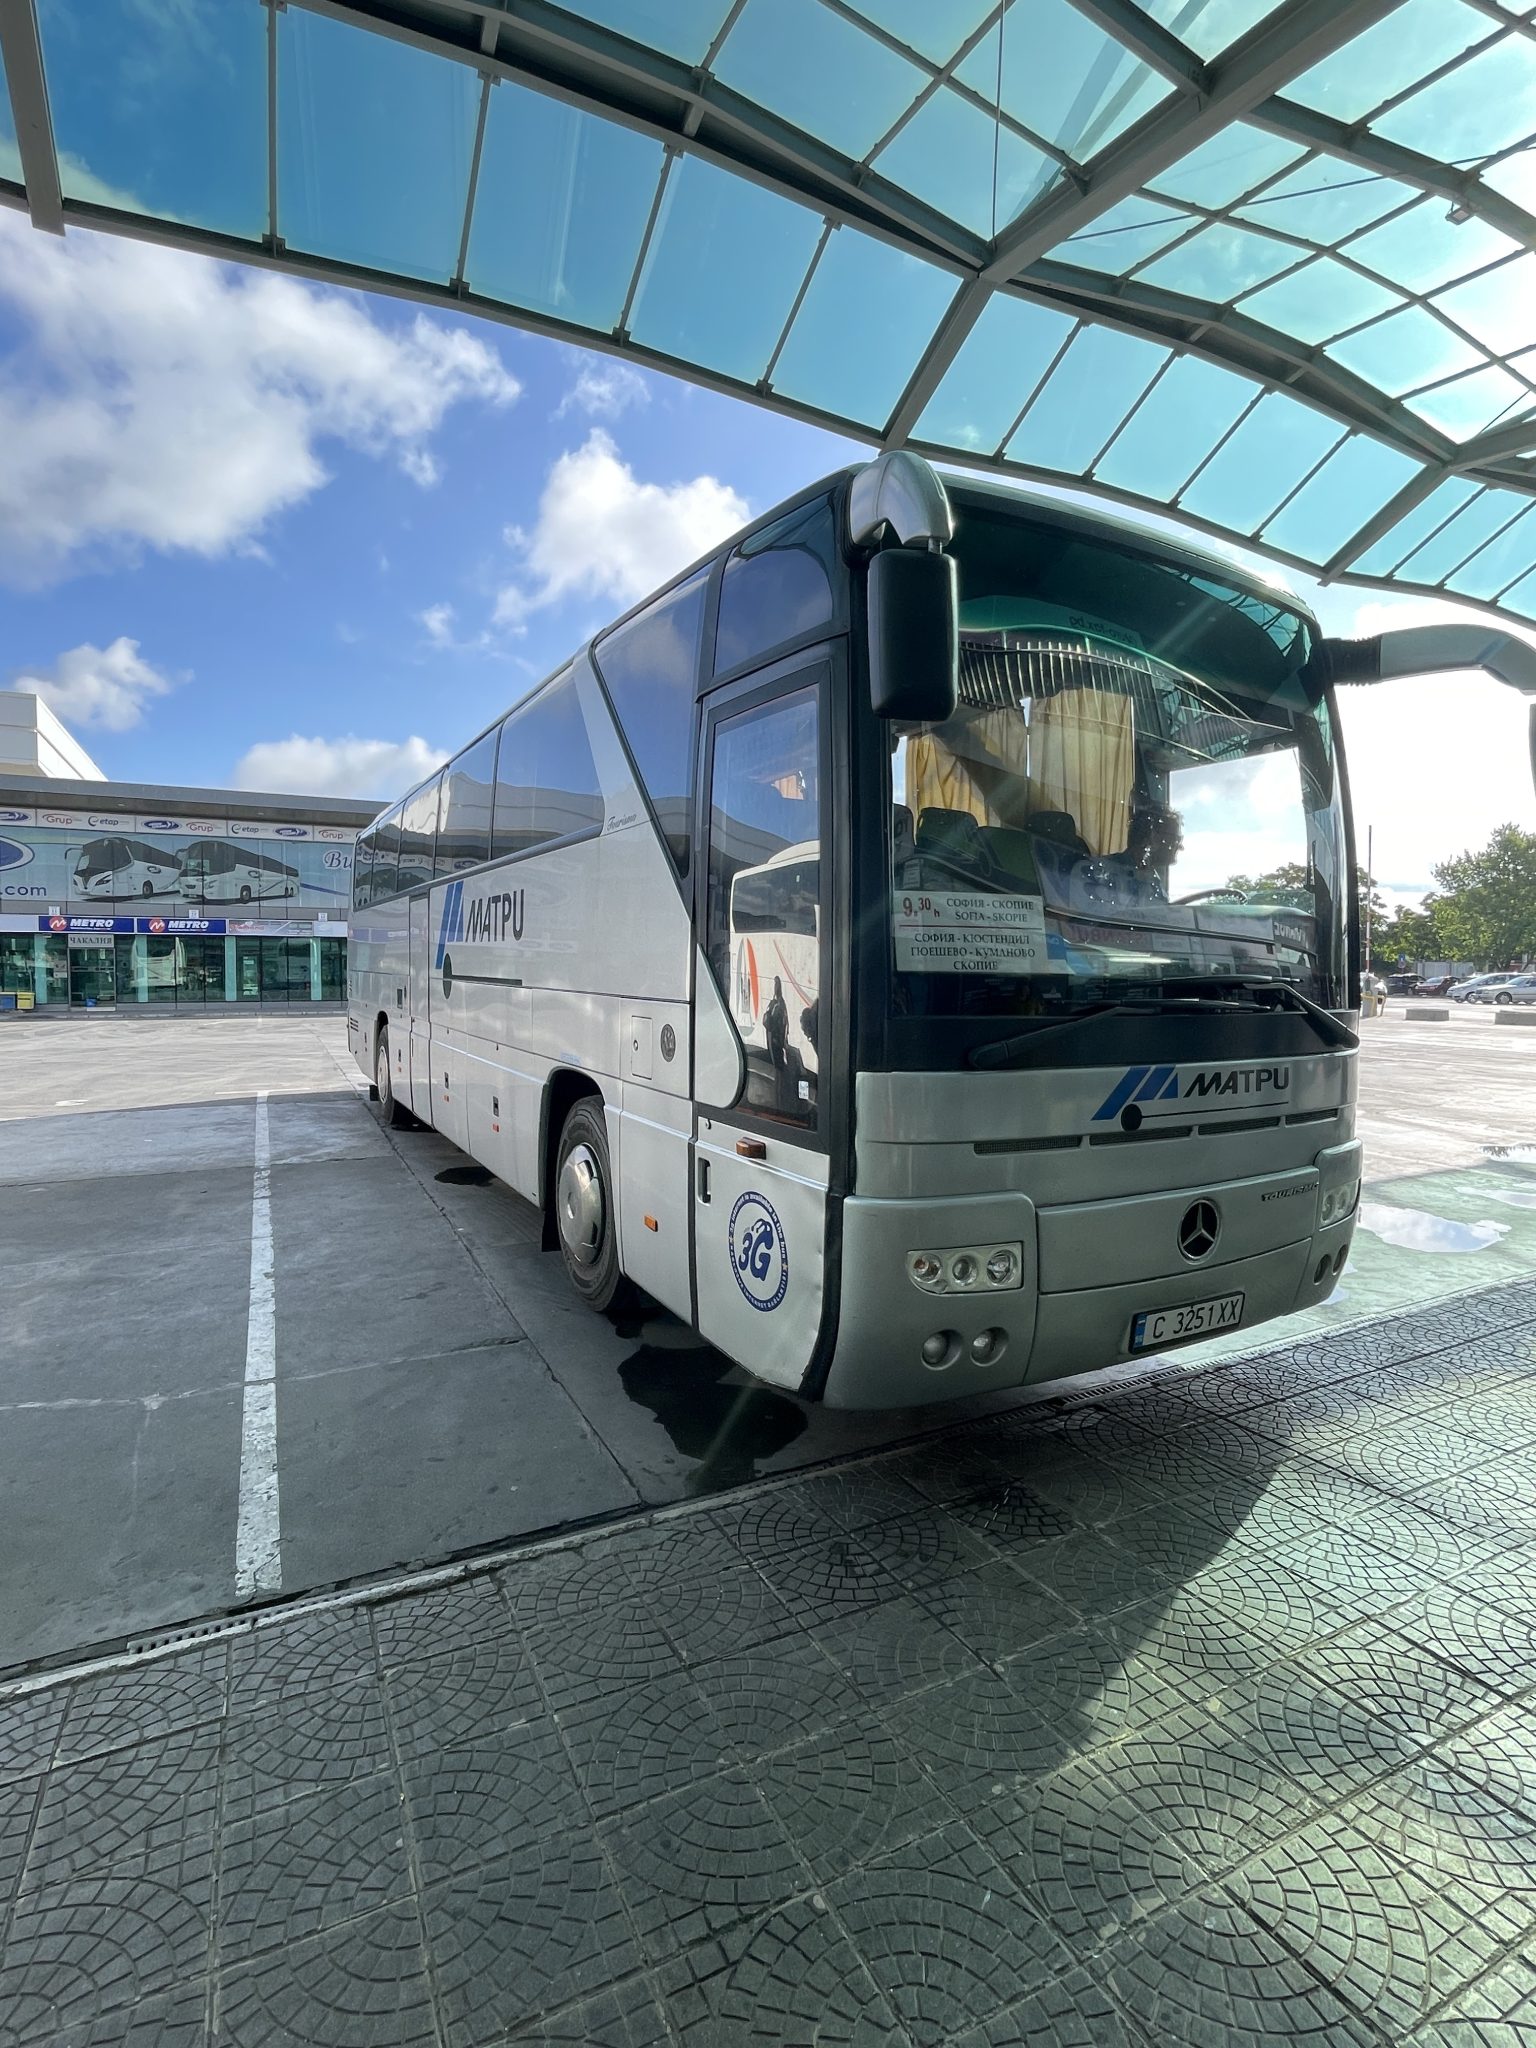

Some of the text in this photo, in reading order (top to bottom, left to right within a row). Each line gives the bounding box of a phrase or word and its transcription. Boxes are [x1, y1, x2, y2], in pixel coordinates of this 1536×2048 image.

[46, 815, 73, 825] Grup
[189, 822, 214, 833] Grup
[320, 830, 344, 840] Grup
[946, 898, 984, 908] СОФИЯ
[992, 900, 1034, 910] СКОПИЕ
[955, 911, 985, 921] SOFIA
[69, 918, 114, 927] METRO
[168, 920, 209, 929] METRO
[914, 933, 955, 943] СОФИЯ
[953, 961, 998, 971] СКОПИЕ
[1183, 1067, 1290, 1098] MATPU
[738, 1219, 774, 1282] 3G
[1152, 1316, 1166, 1338] C
